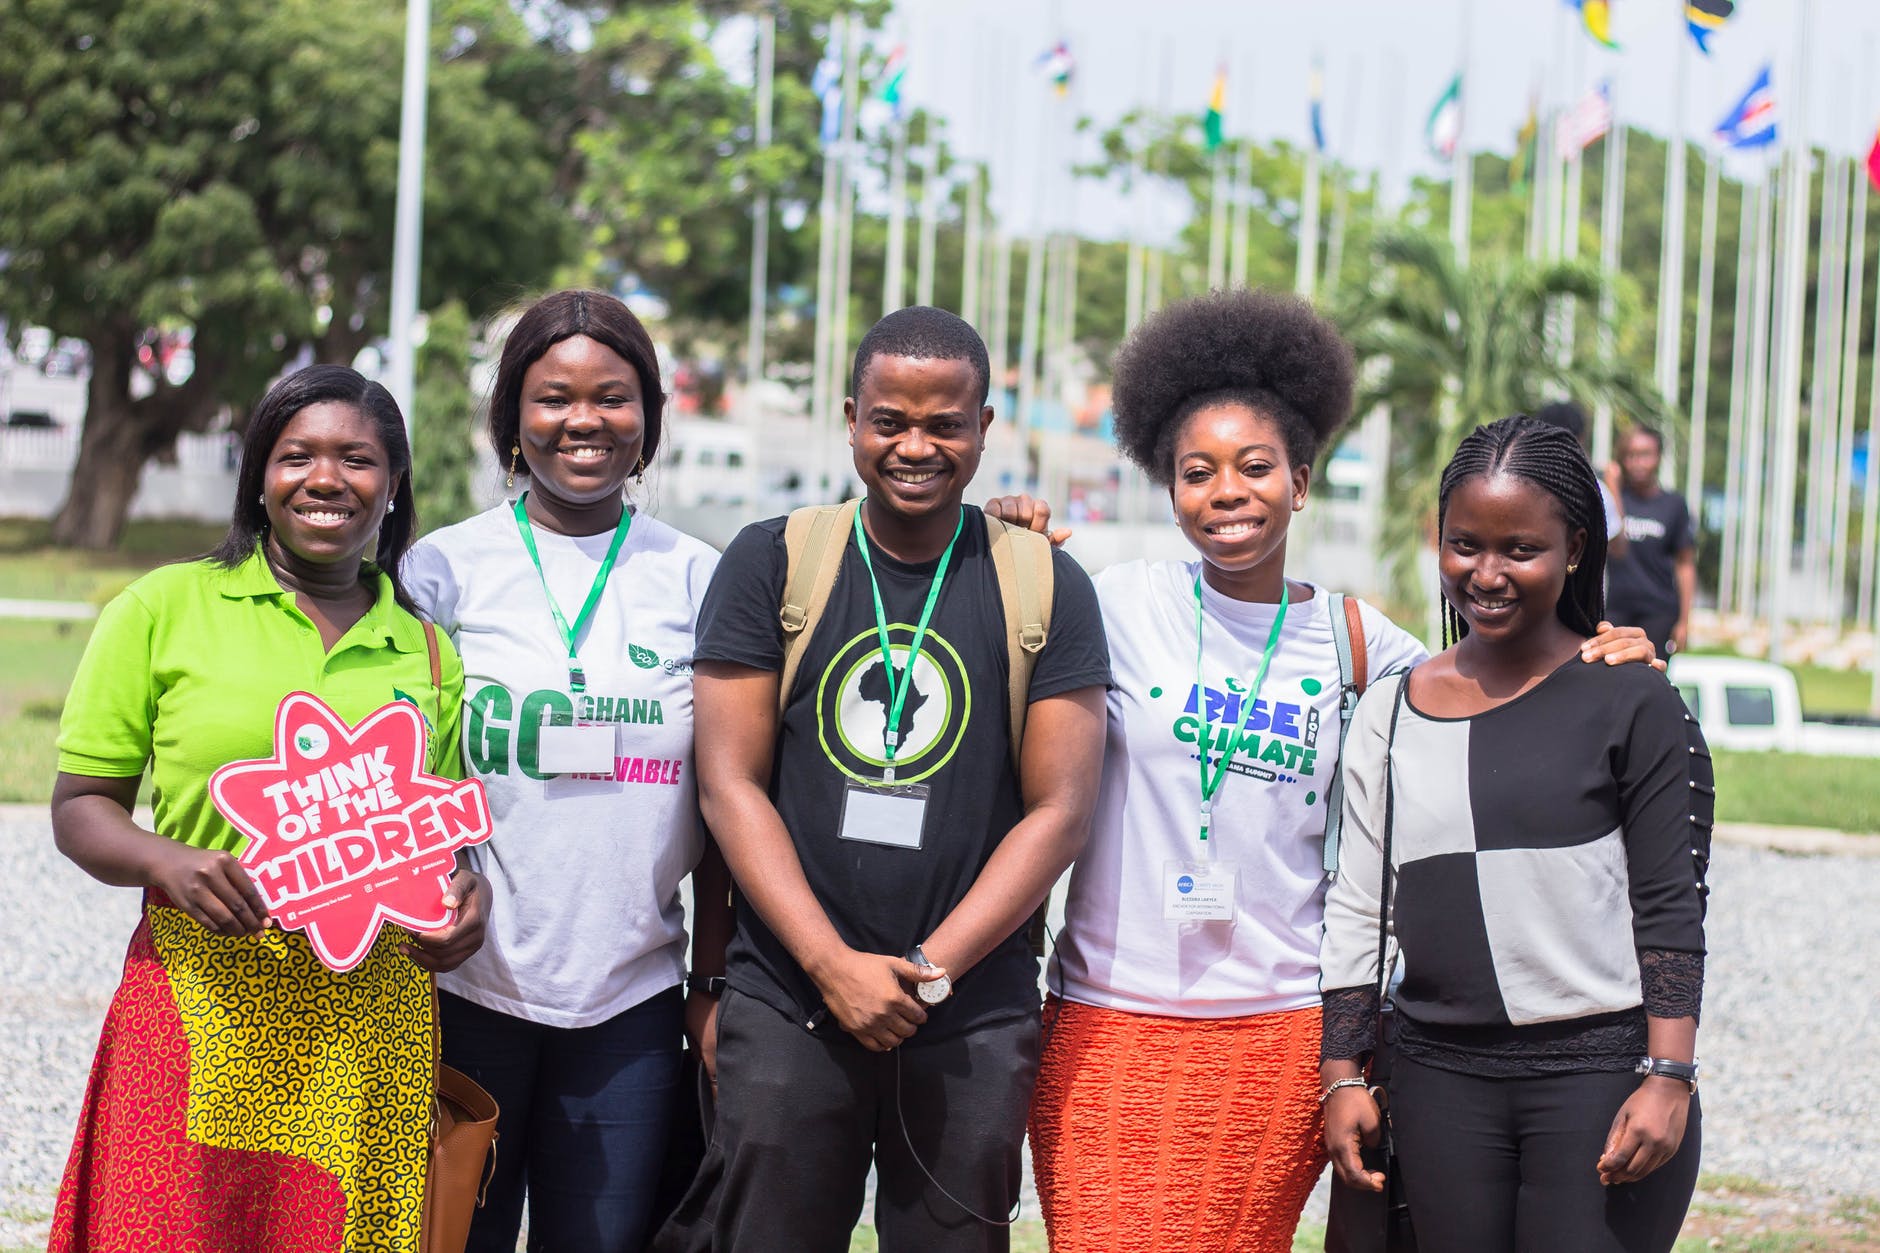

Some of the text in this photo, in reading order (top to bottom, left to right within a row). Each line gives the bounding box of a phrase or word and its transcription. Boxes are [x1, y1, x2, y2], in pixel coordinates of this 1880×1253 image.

[468, 685, 574, 781] GO
[578, 696, 664, 725] GHANA
[1183, 683, 1301, 739] RISE
[1307, 711, 1318, 743] FOR
[1172, 715, 1317, 776] CLIMATE
[262, 745, 396, 817] THINK
[277, 776, 403, 841] OF THE
[253, 788, 486, 904] HILDREN
